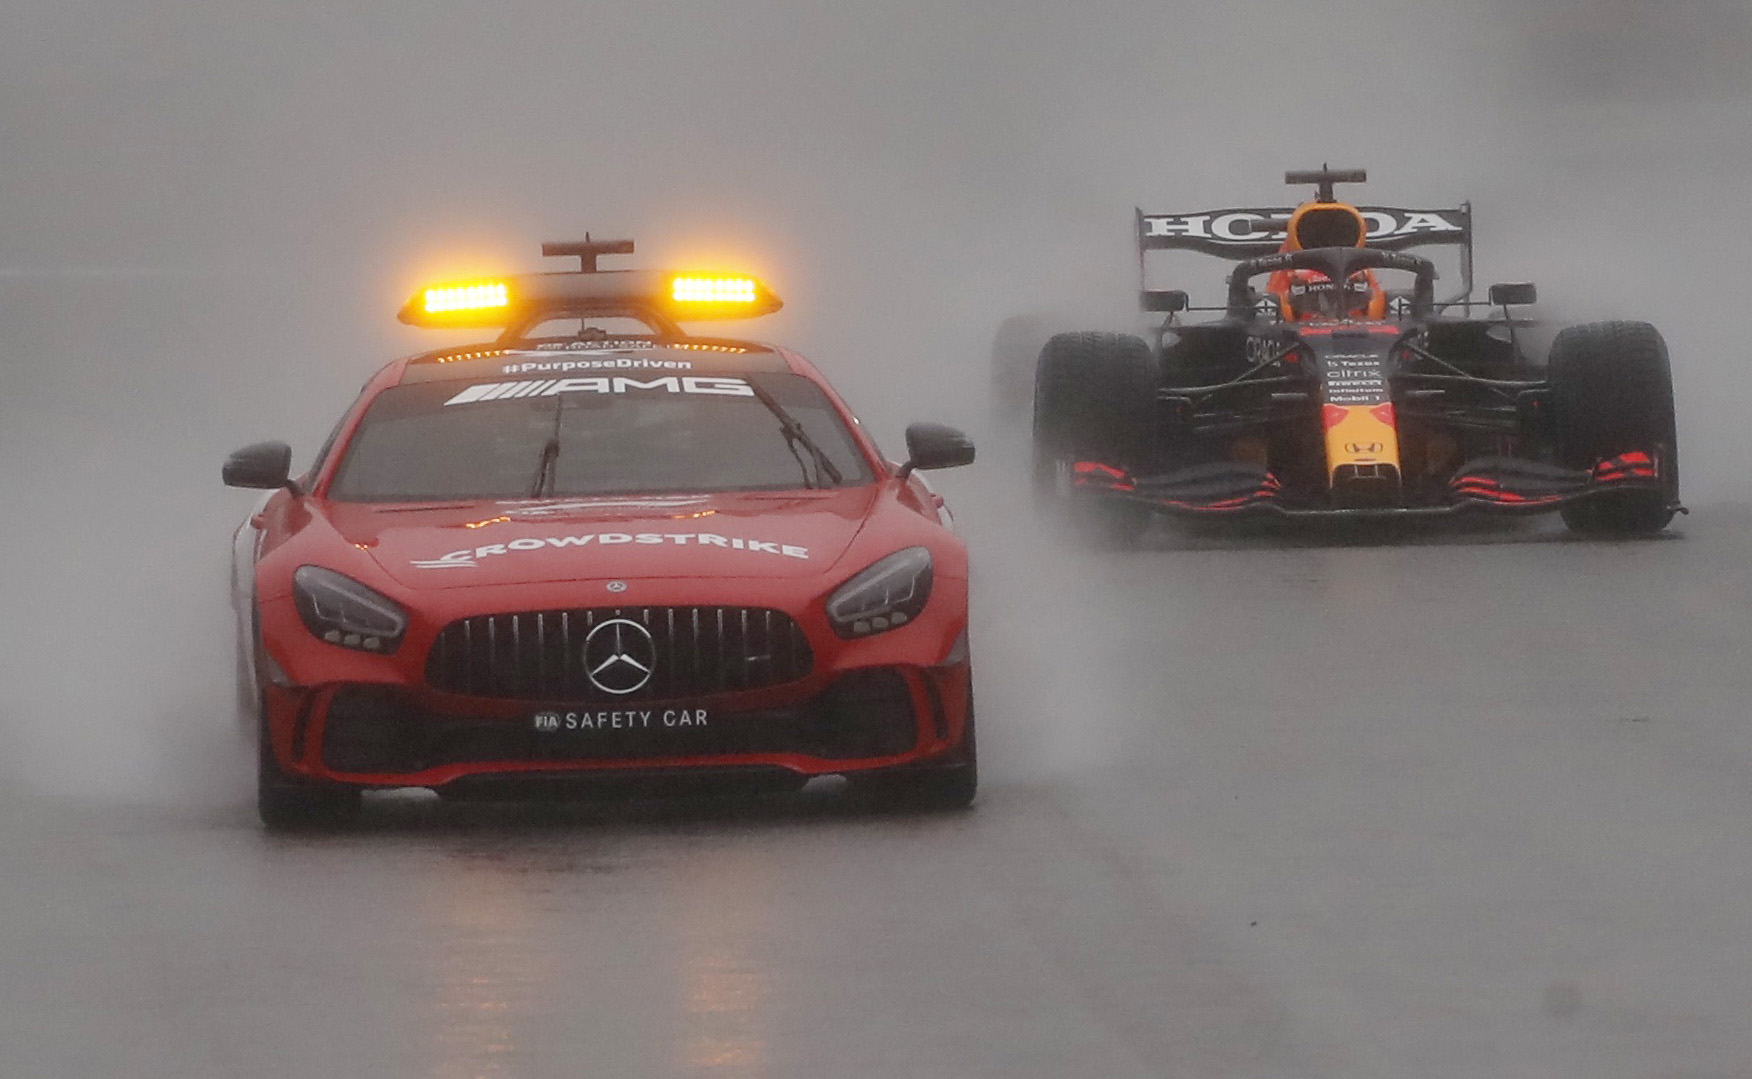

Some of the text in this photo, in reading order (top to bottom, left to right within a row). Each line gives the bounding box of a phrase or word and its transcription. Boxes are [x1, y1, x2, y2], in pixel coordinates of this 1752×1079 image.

[1144, 212, 1462, 239] HODA
[502, 358, 692, 374] #PurposeDriven
[541, 376, 755, 397] AMG
[440, 532, 809, 562] CROWDSTRIKE
[534, 709, 708, 730] FIA SAFETY CAR
